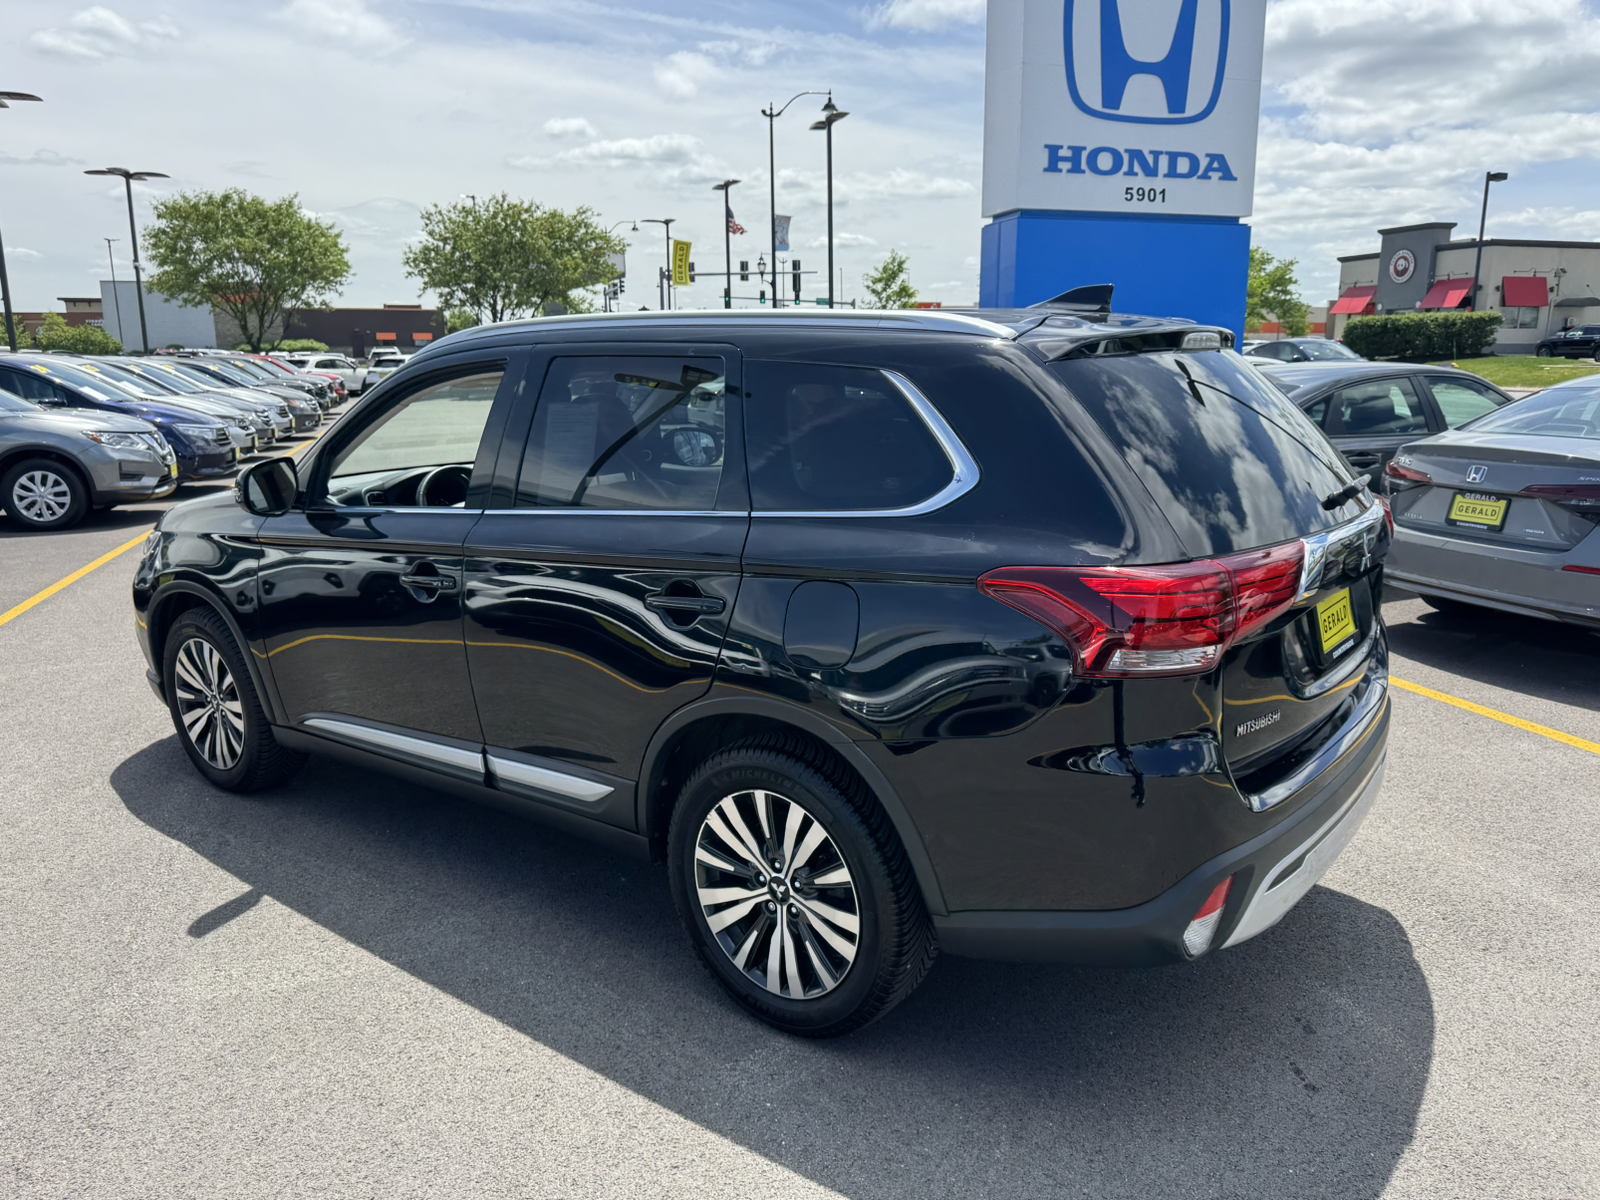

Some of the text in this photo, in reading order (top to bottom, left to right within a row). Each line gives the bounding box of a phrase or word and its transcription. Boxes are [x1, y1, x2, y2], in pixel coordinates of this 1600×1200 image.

[1043, 144, 1238, 181] HONDA
[1124, 187, 1167, 203] 5901
[677, 246, 685, 281] GERALD
[1458, 505, 1497, 517] GERALD
[1322, 605, 1348, 634] GERALD
[1236, 710, 1281, 737] MITSUBISHI
[731, 770, 793, 788] MICHELIN
